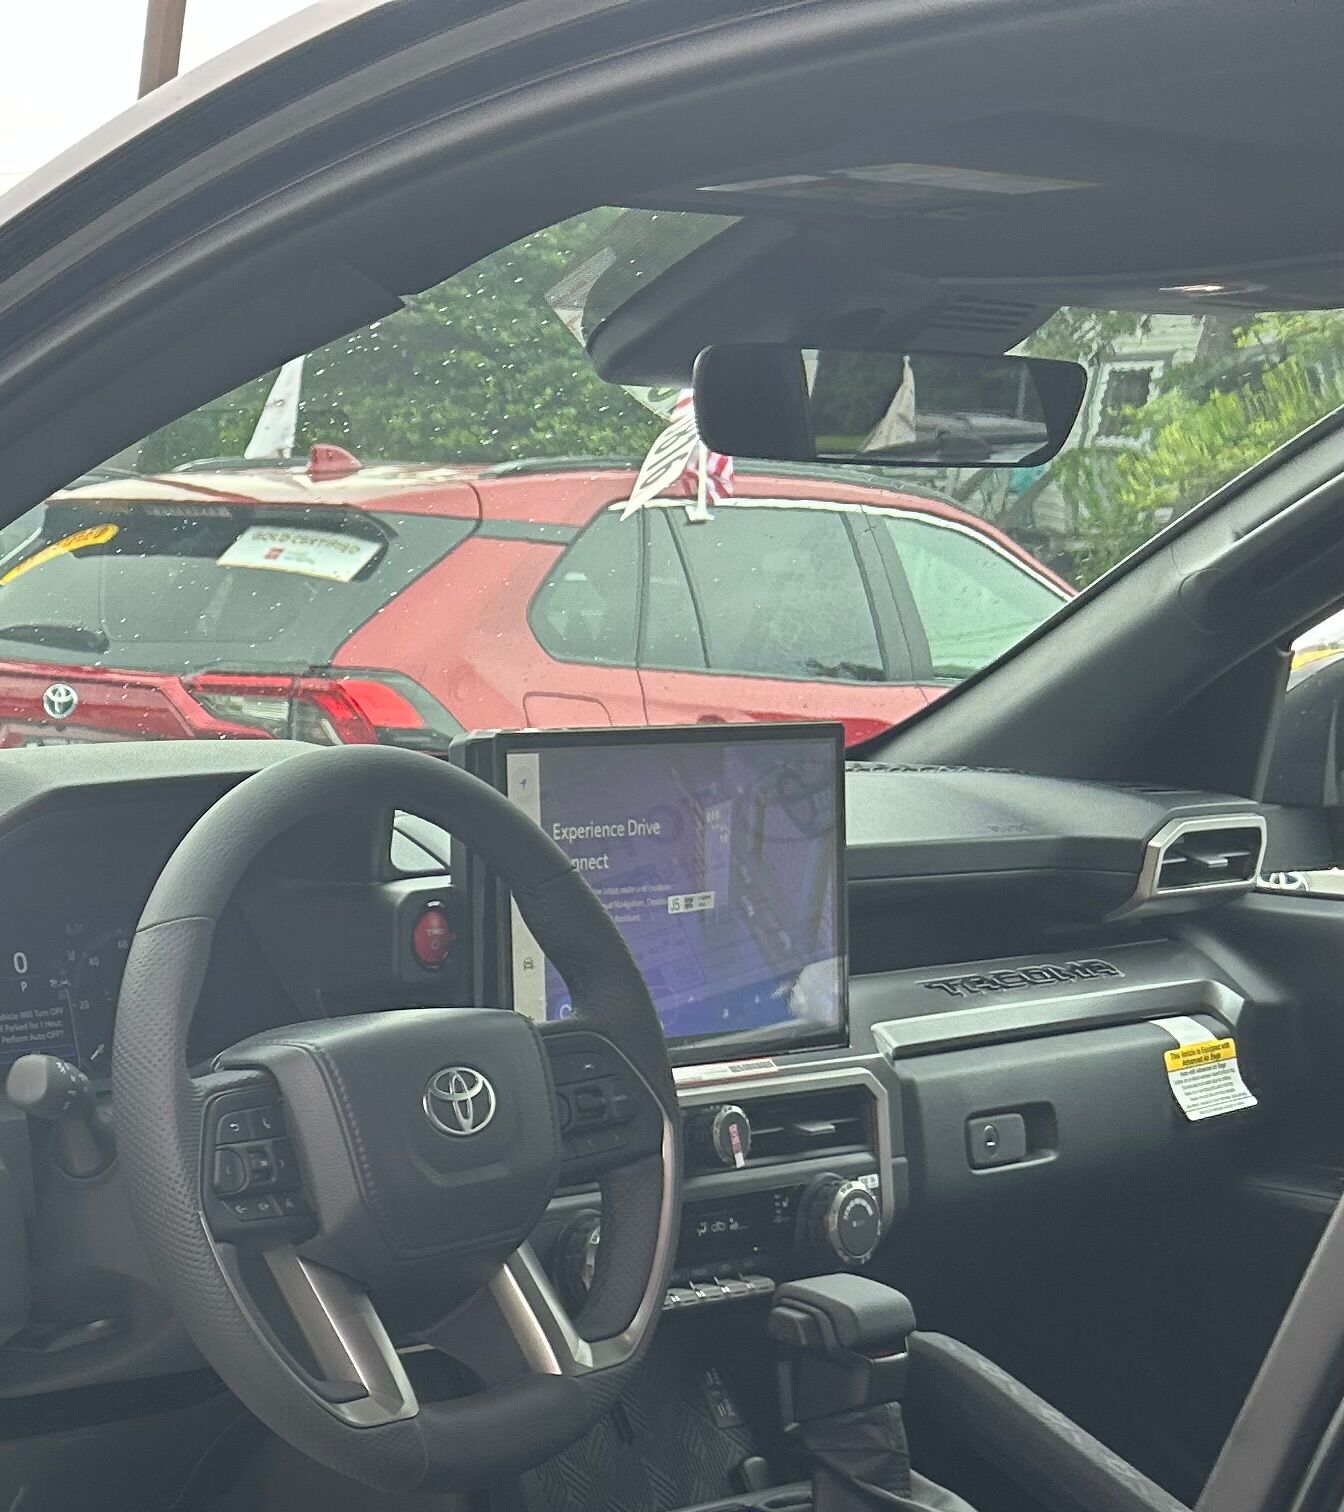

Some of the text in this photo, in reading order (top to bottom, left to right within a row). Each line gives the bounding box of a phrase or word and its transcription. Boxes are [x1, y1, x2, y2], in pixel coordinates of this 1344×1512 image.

[553, 817, 661, 844] Experience Drive
[572, 854, 609, 870] nnect
[13, 952, 27, 974] 0
[918, 958, 1125, 997] TACOMA
